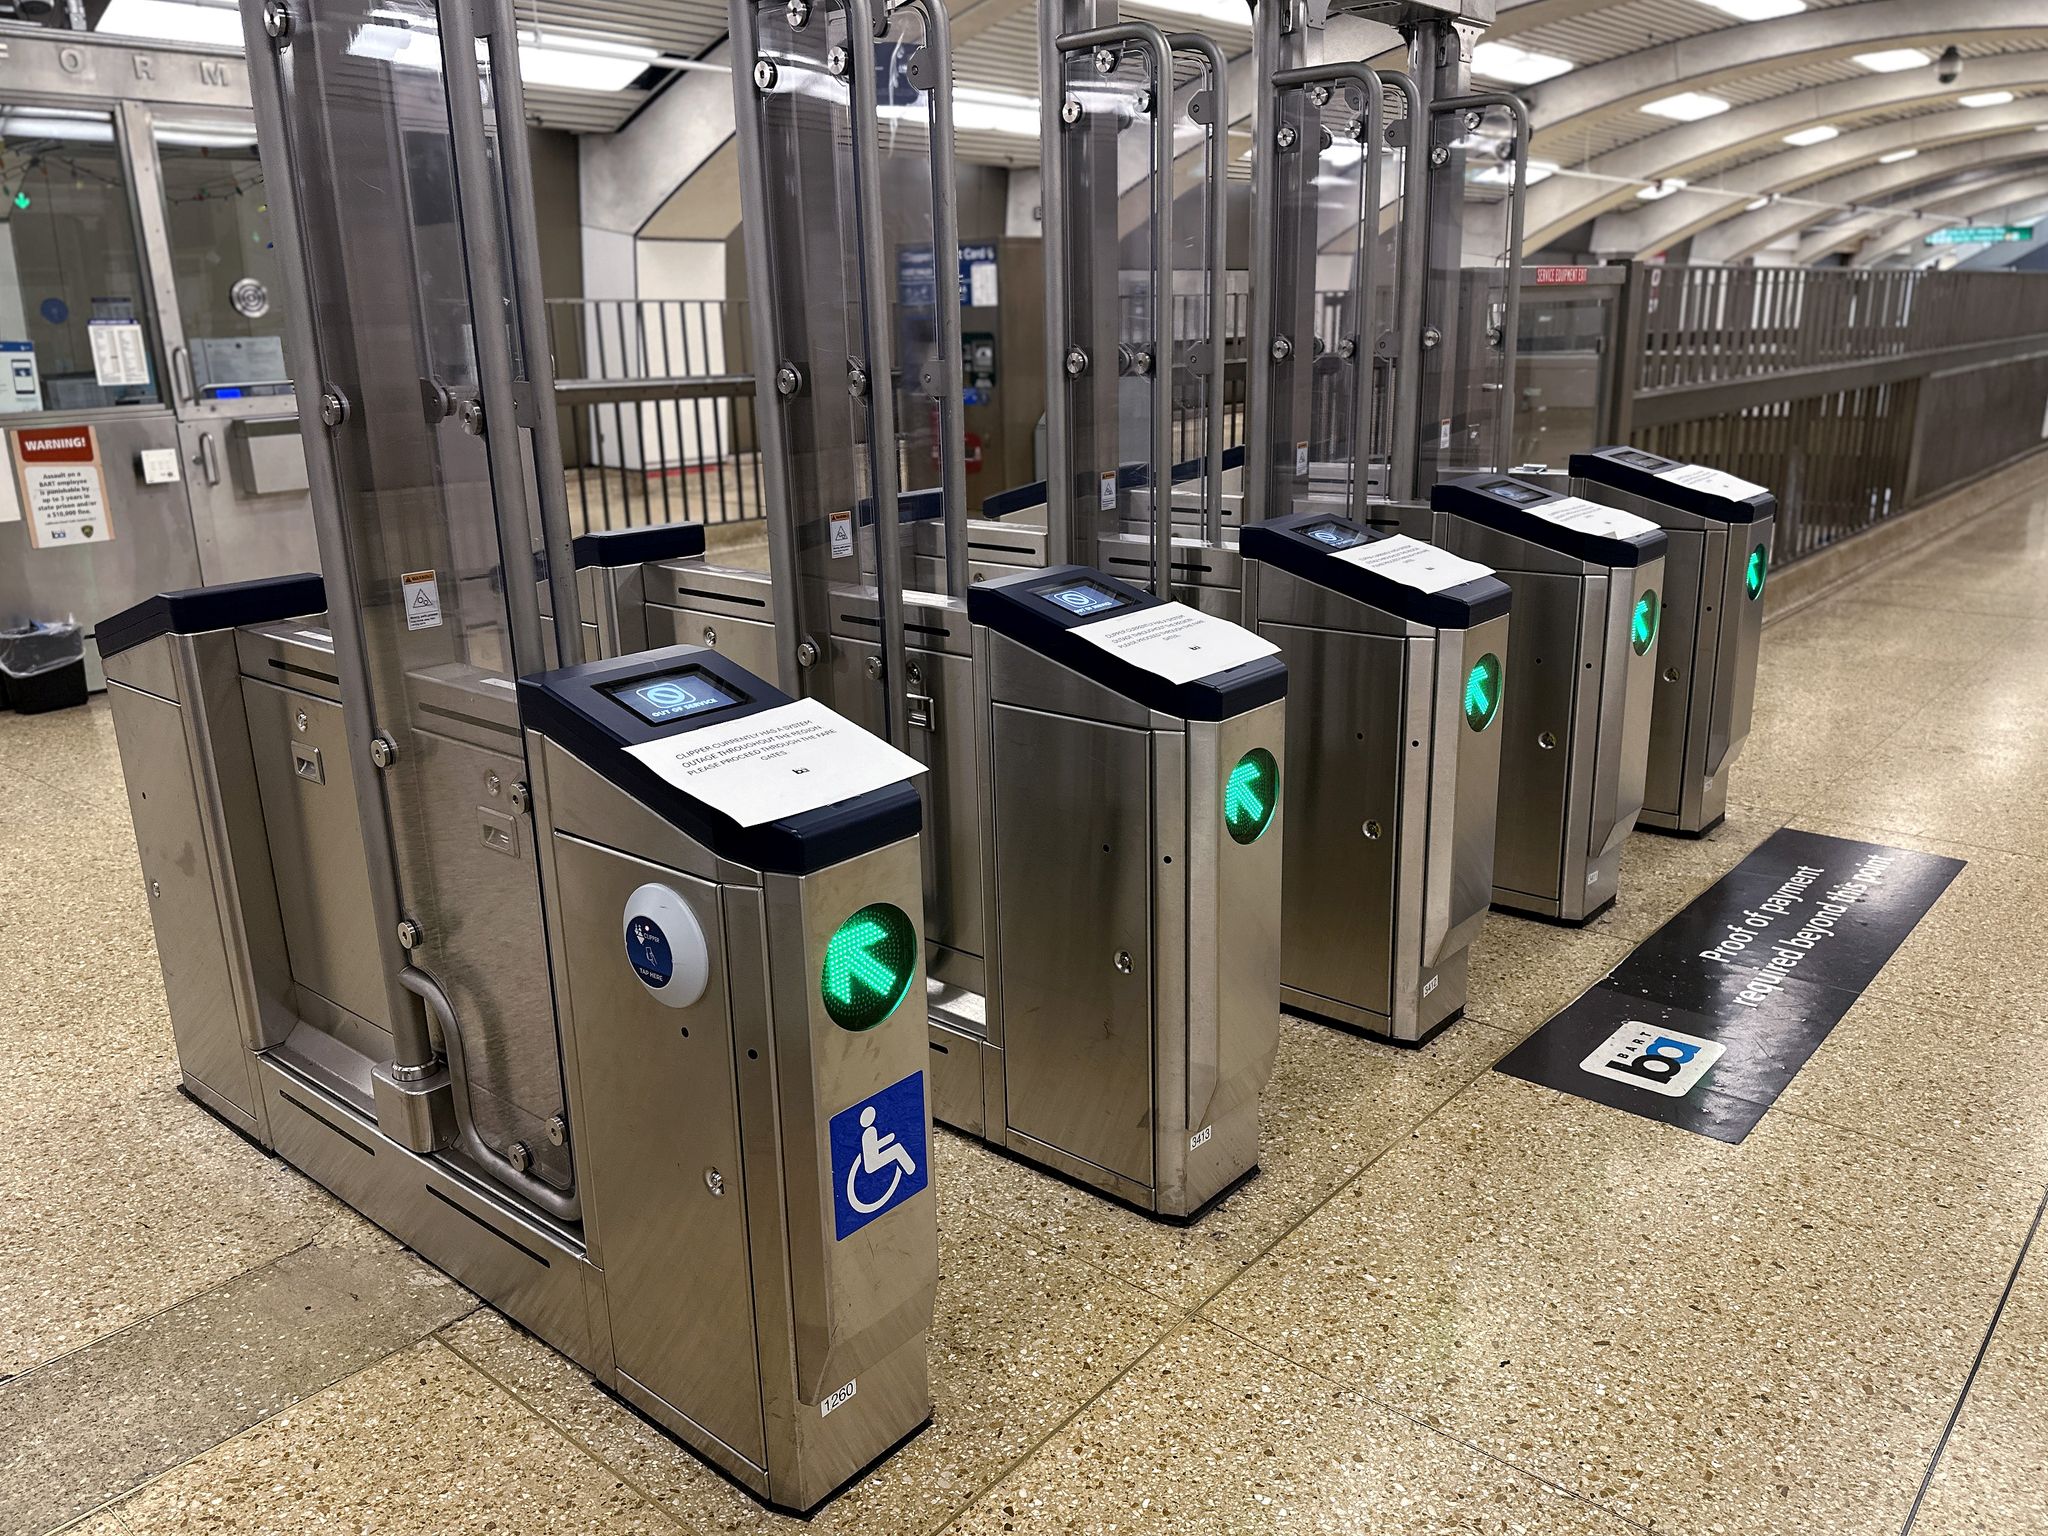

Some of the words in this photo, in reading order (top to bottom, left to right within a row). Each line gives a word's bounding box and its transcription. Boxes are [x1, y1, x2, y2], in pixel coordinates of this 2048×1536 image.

[1537, 268, 1555, 282] SERVICE
[25, 437, 86, 451] WARNING!
[43, 471, 65, 480] Assault
[47, 486, 80, 496] punishable
[651, 708, 671, 717] OUT
[671, 705, 684, 713] OF
[683, 697, 719, 711] SERVICE
[675, 745, 713, 760] CLIPPER
[711, 732, 759, 749] CURRENTLY
[759, 727, 778, 738] HAS
[782, 719, 813, 731] SYSTEM
[681, 752, 719, 769] OUTAGE
[717, 736, 776, 757] THROUGHOUT
[775, 732, 792, 740] THE
[687, 761, 721, 776] PLEASE
[719, 749, 761, 766] PROCEED
[760, 738, 802, 753] THROUGH
[800, 734, 818, 743] THE
[815, 728, 837, 738] FARE
[1758, 865, 1825, 916] payment
[1743, 909, 1775, 928] of
[643, 932, 660, 943] CLIPPER
[1732, 945, 1806, 1010] required
[1777, 900, 1848, 950] beyond
[1826, 884, 1868, 904] this
[1851, 853, 1895, 885] point
[1699, 924, 1759, 963] Proof
[639, 967, 649, 976] TAP
[649, 971, 663, 982] HERE
[1617, 1031, 1652, 1059] BART
[1191, 1128, 1210, 1148] 3413
[824, 1382, 854, 1411] 1260
